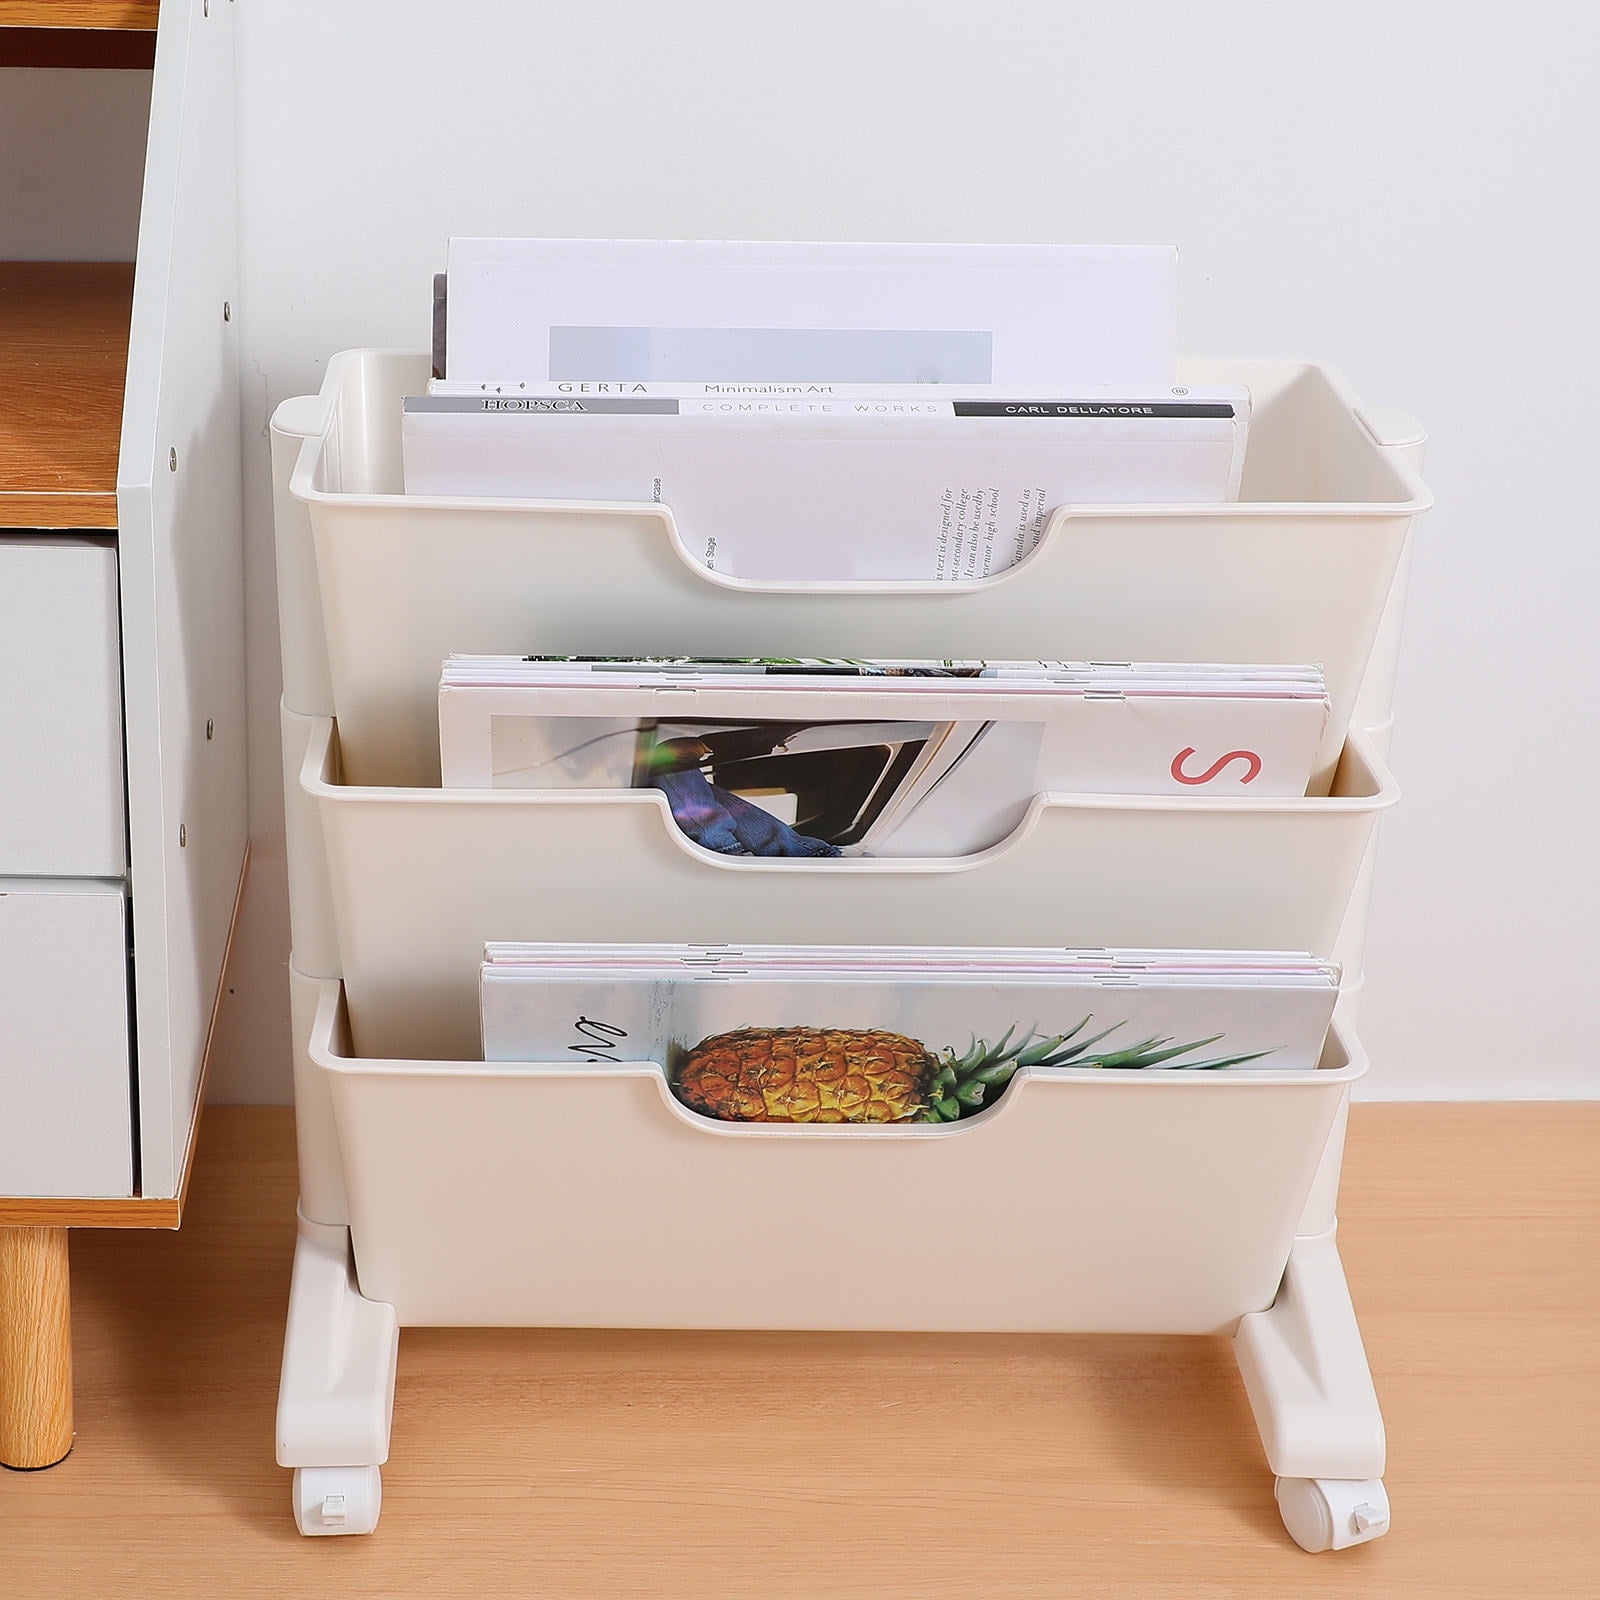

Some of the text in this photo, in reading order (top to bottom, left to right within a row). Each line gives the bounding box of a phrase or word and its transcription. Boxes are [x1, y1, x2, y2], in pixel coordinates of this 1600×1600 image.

[558, 383, 648, 393] GERTA
[705, 384, 834, 394] Minimalism Art
[481, 399, 588, 412] HOPSCA
[702, 403, 937, 413] COMPLETE WORKS
[1005, 405, 1153, 415] CARL DELLATORE
[941, 488, 954, 504] for
[988, 487, 1000, 517] school
[1022, 488, 1031, 500] as
[955, 488, 971, 520] college
[1018, 501, 1030, 522] used
[1032, 488, 1047, 528] imperial
[937, 503, 952, 544] designed
[969, 521, 980, 532] be
[982, 521, 998, 542] high
[706, 537, 717, 558] Stage
[967, 534, 979, 552] also
[936, 554, 946, 572] text
[968, 553, 977, 569] can
[963, 569, 975, 578] It
[1170, 747, 1262, 785] S
